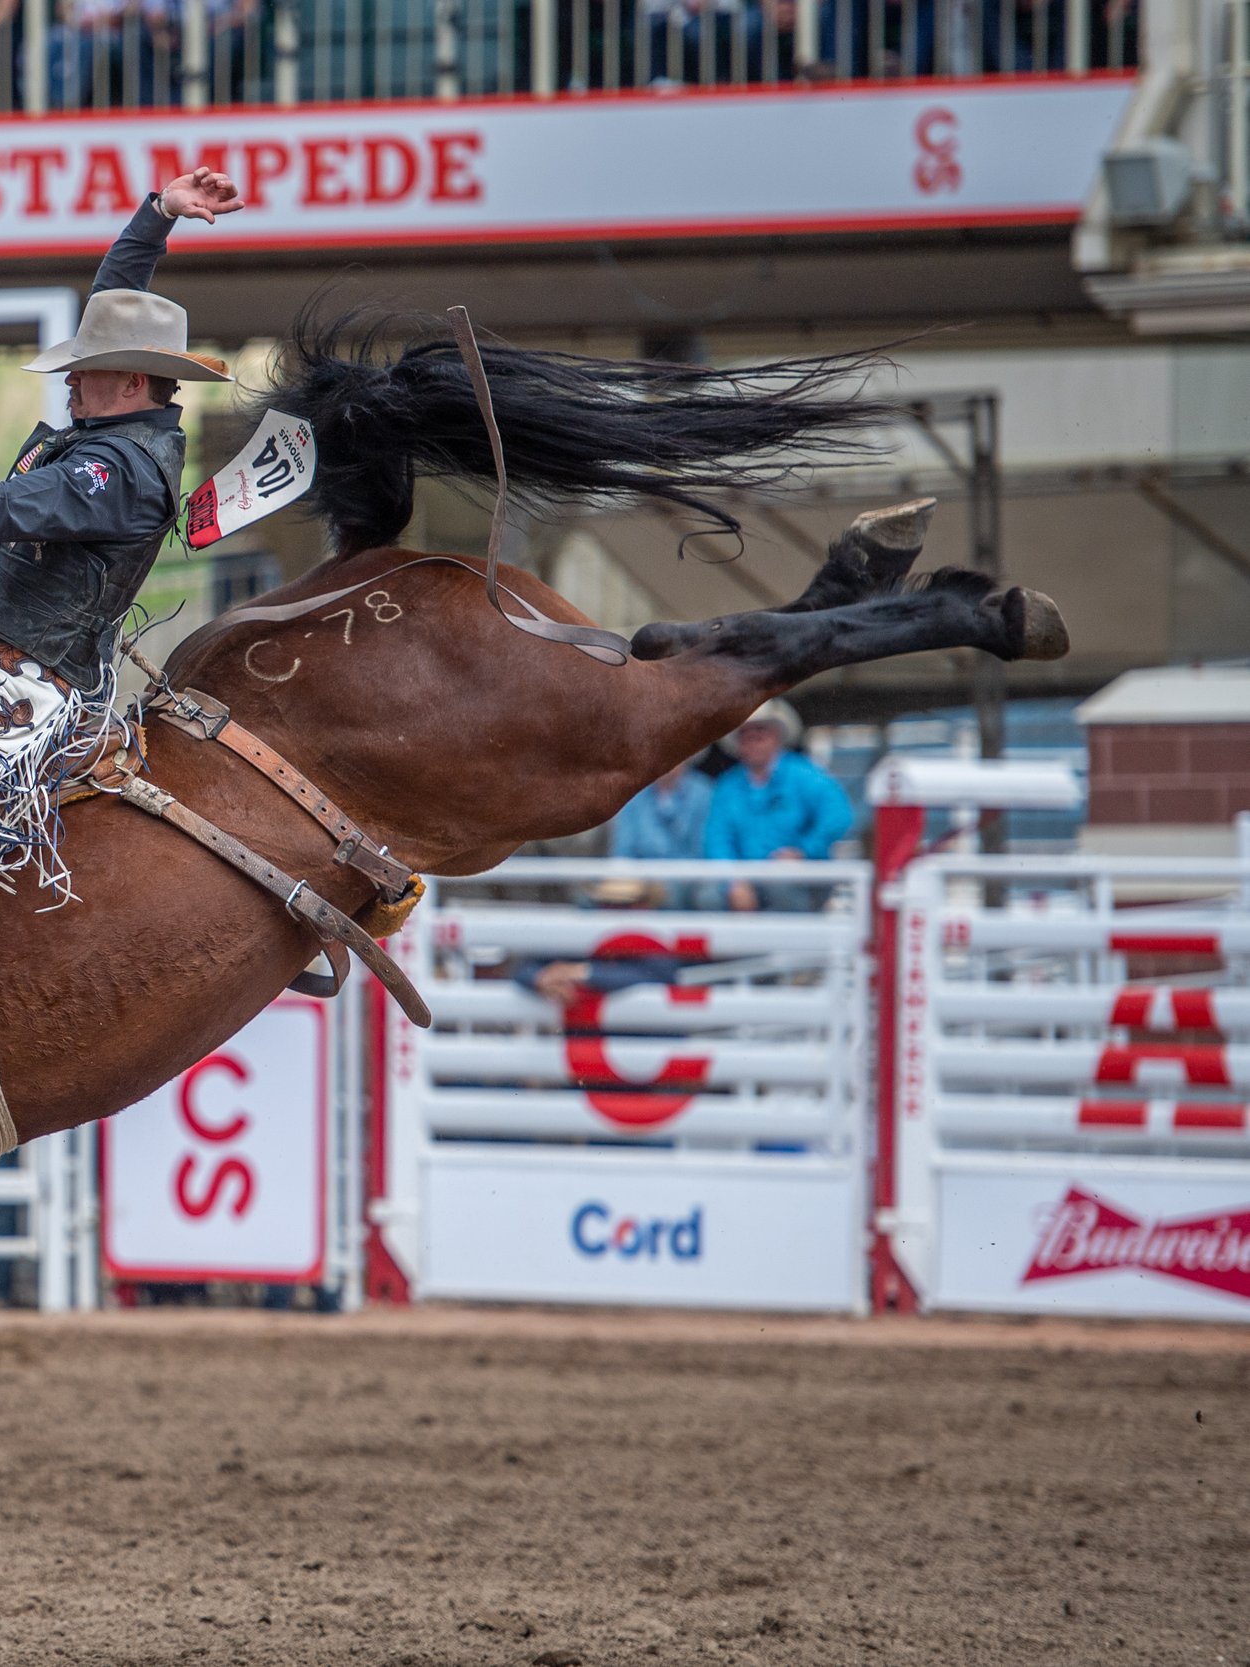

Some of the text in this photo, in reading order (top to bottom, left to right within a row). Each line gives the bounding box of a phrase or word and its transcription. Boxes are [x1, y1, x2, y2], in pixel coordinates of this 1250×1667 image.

[252, 434, 295, 498] 104
[279, 428, 305, 474] cenovus
[571, 1201, 702, 1260] Cord
